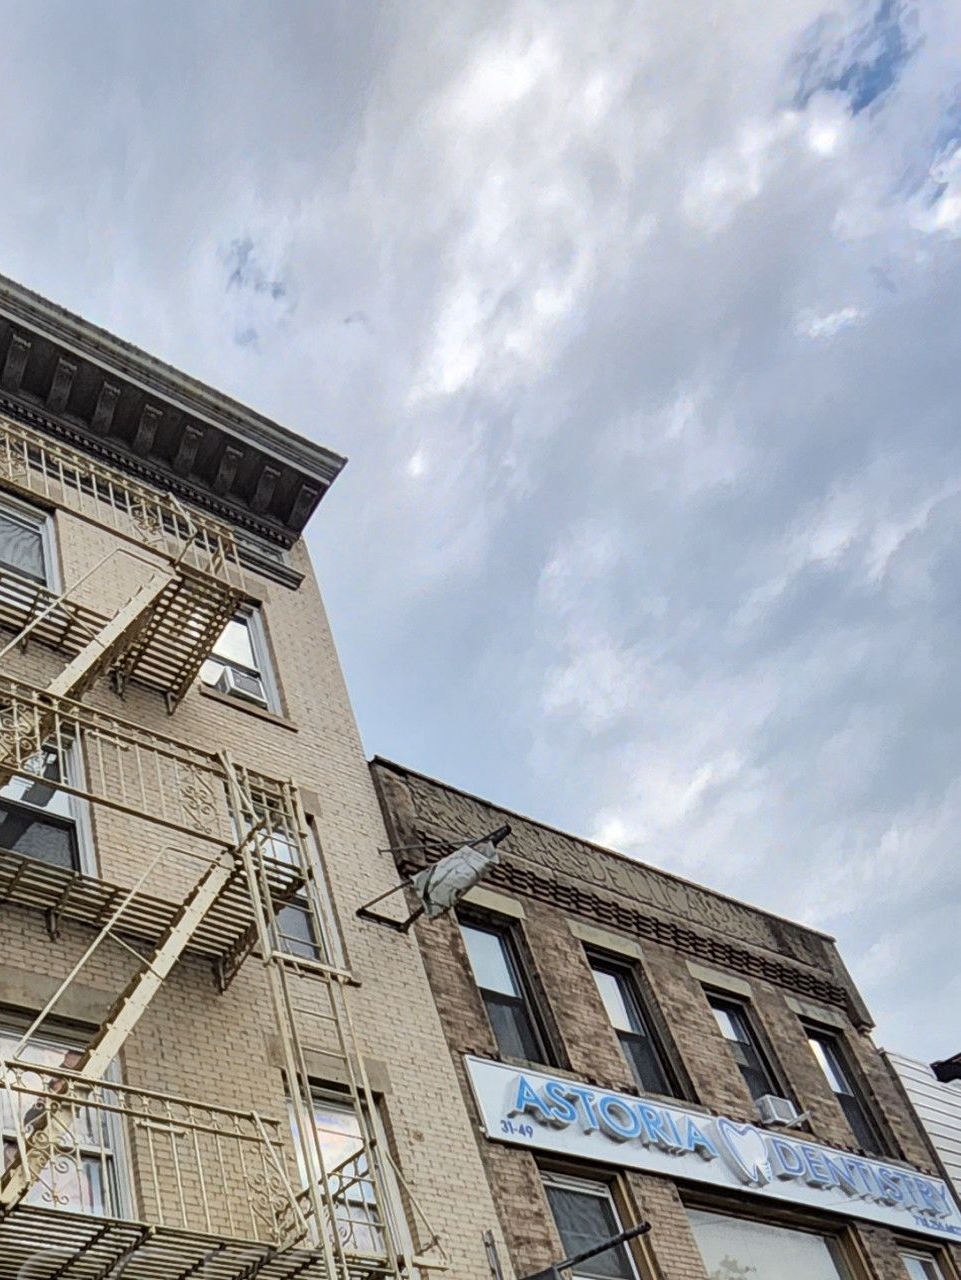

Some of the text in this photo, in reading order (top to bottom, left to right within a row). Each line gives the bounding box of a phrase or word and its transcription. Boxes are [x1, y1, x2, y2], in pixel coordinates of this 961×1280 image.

[500, 1119, 534, 1139] 31-49
[515, 1075, 952, 1216] ASTORIA DENTISTRY
